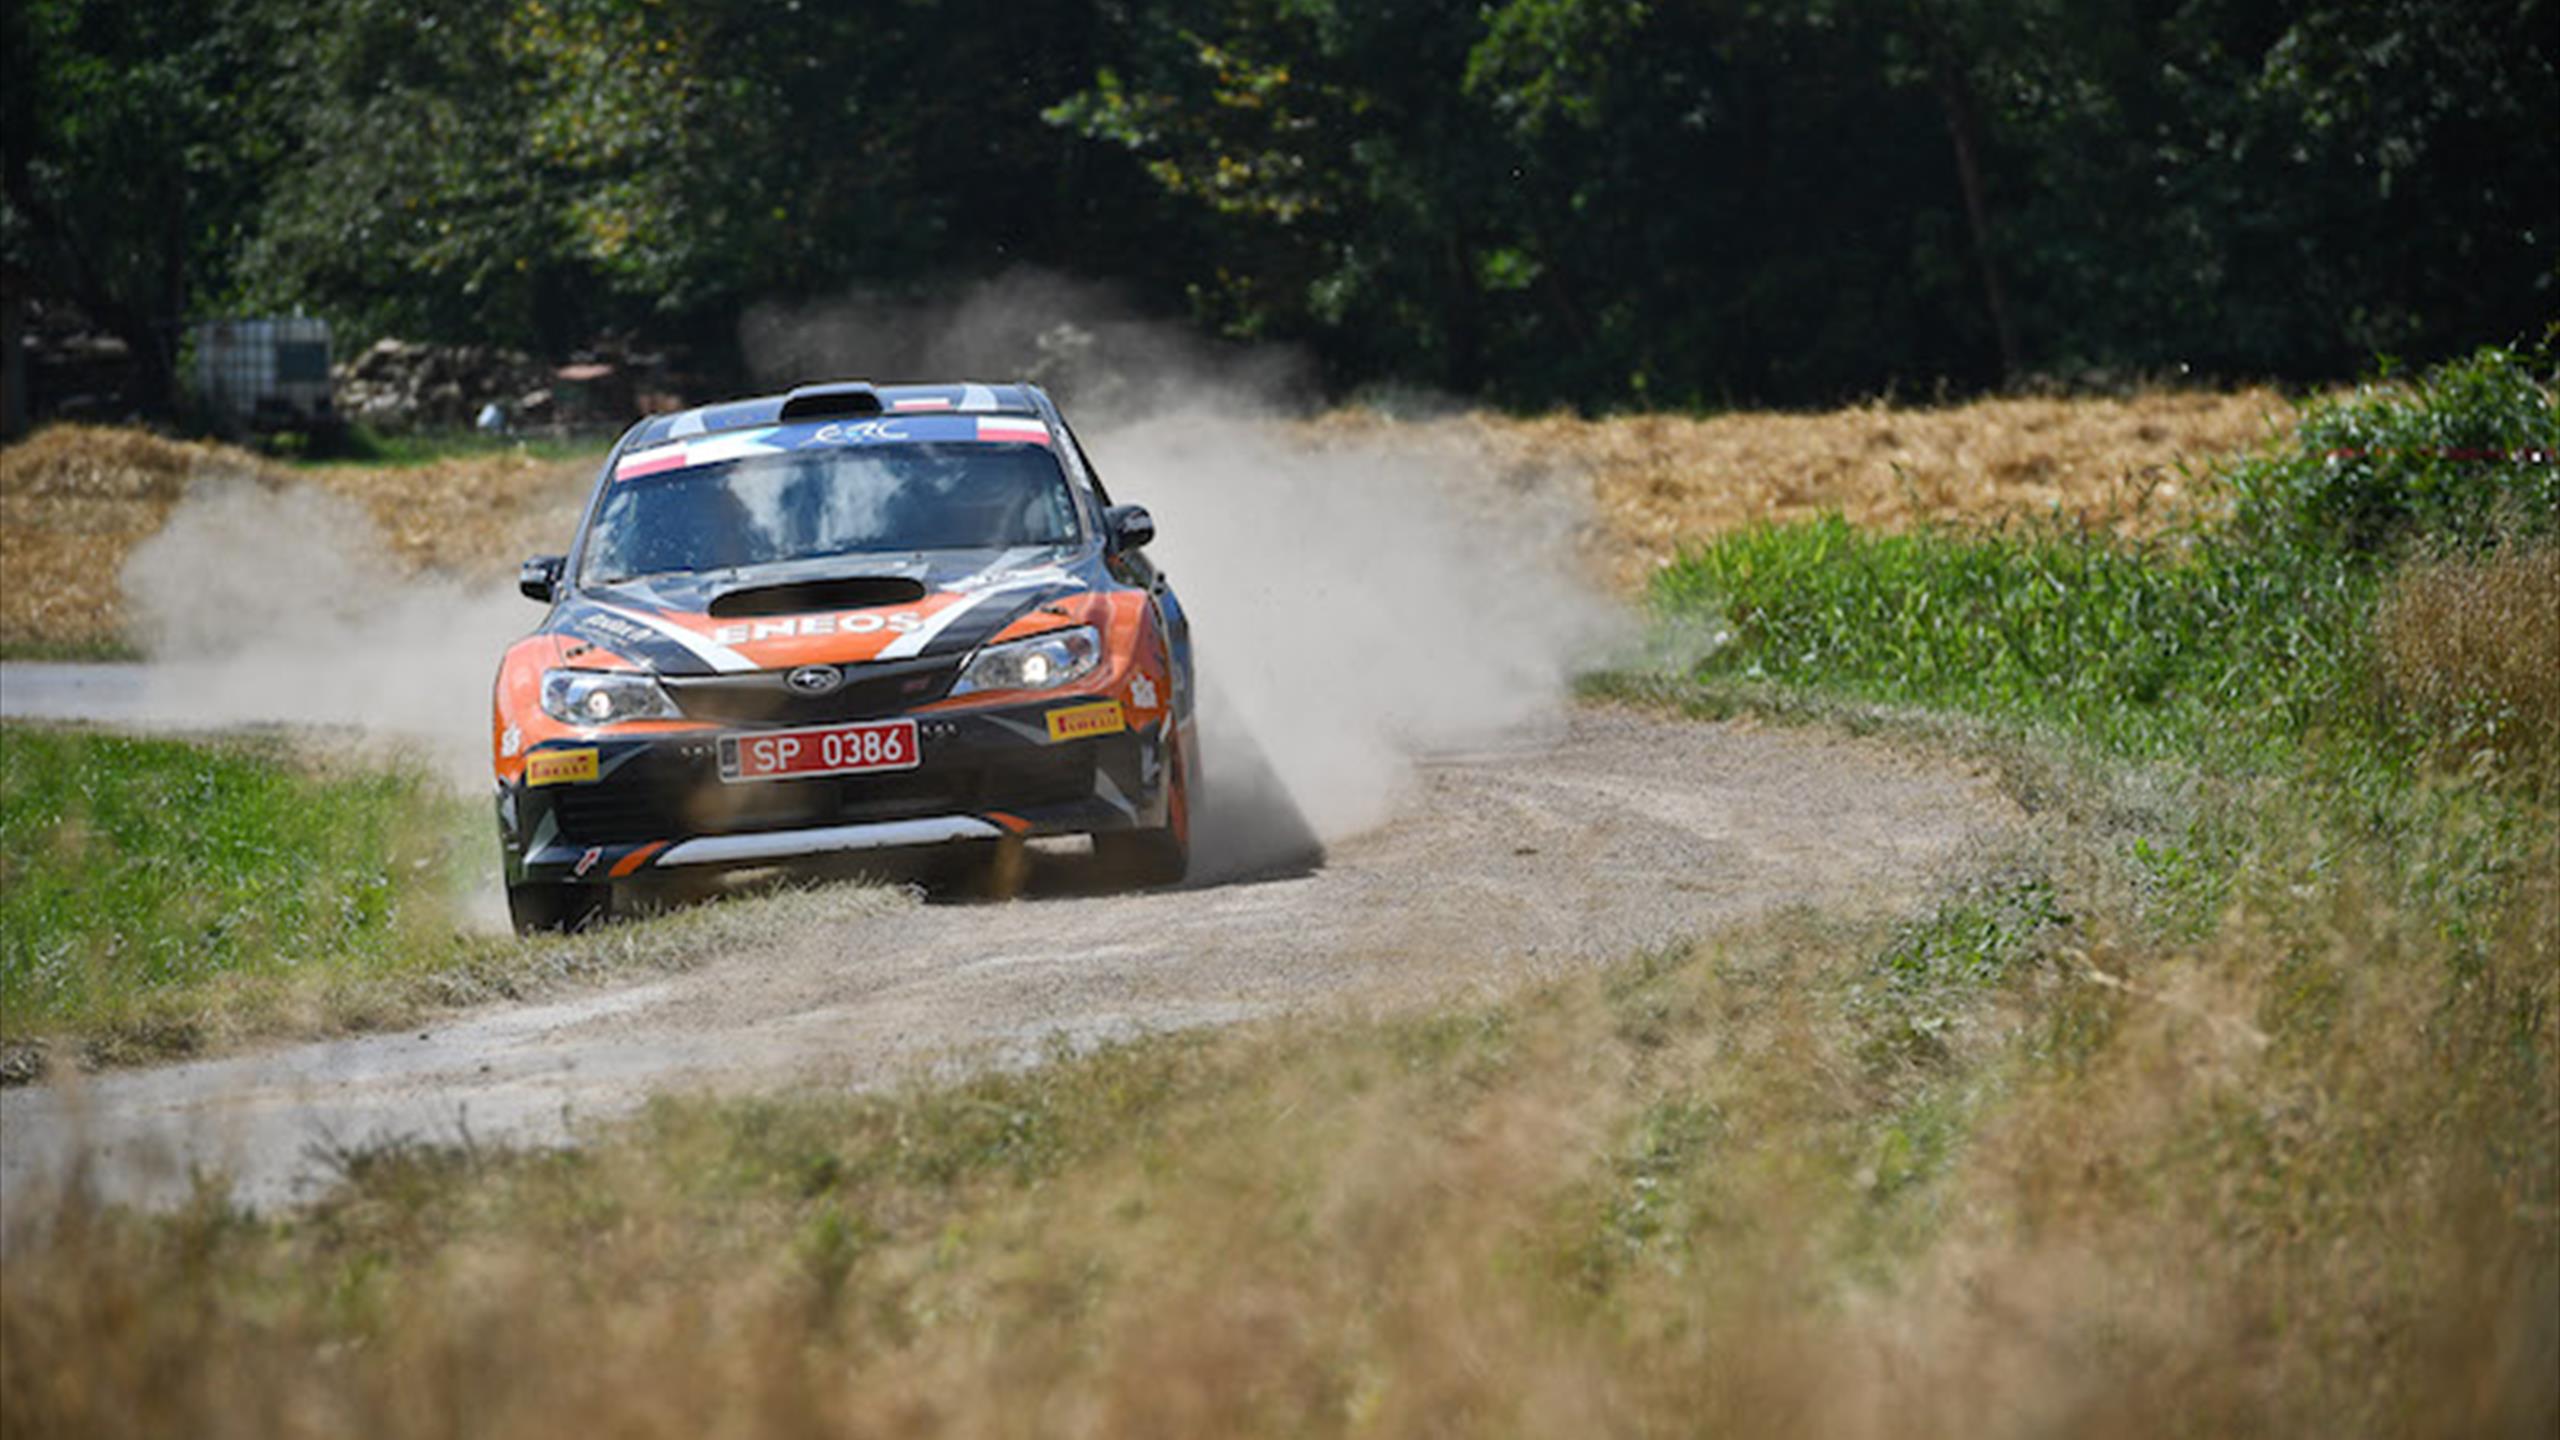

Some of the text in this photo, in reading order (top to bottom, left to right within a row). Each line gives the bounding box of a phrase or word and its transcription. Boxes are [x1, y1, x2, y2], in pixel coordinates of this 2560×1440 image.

[714, 611, 922, 647] ENEOS
[753, 727, 903, 772] SP 0386
